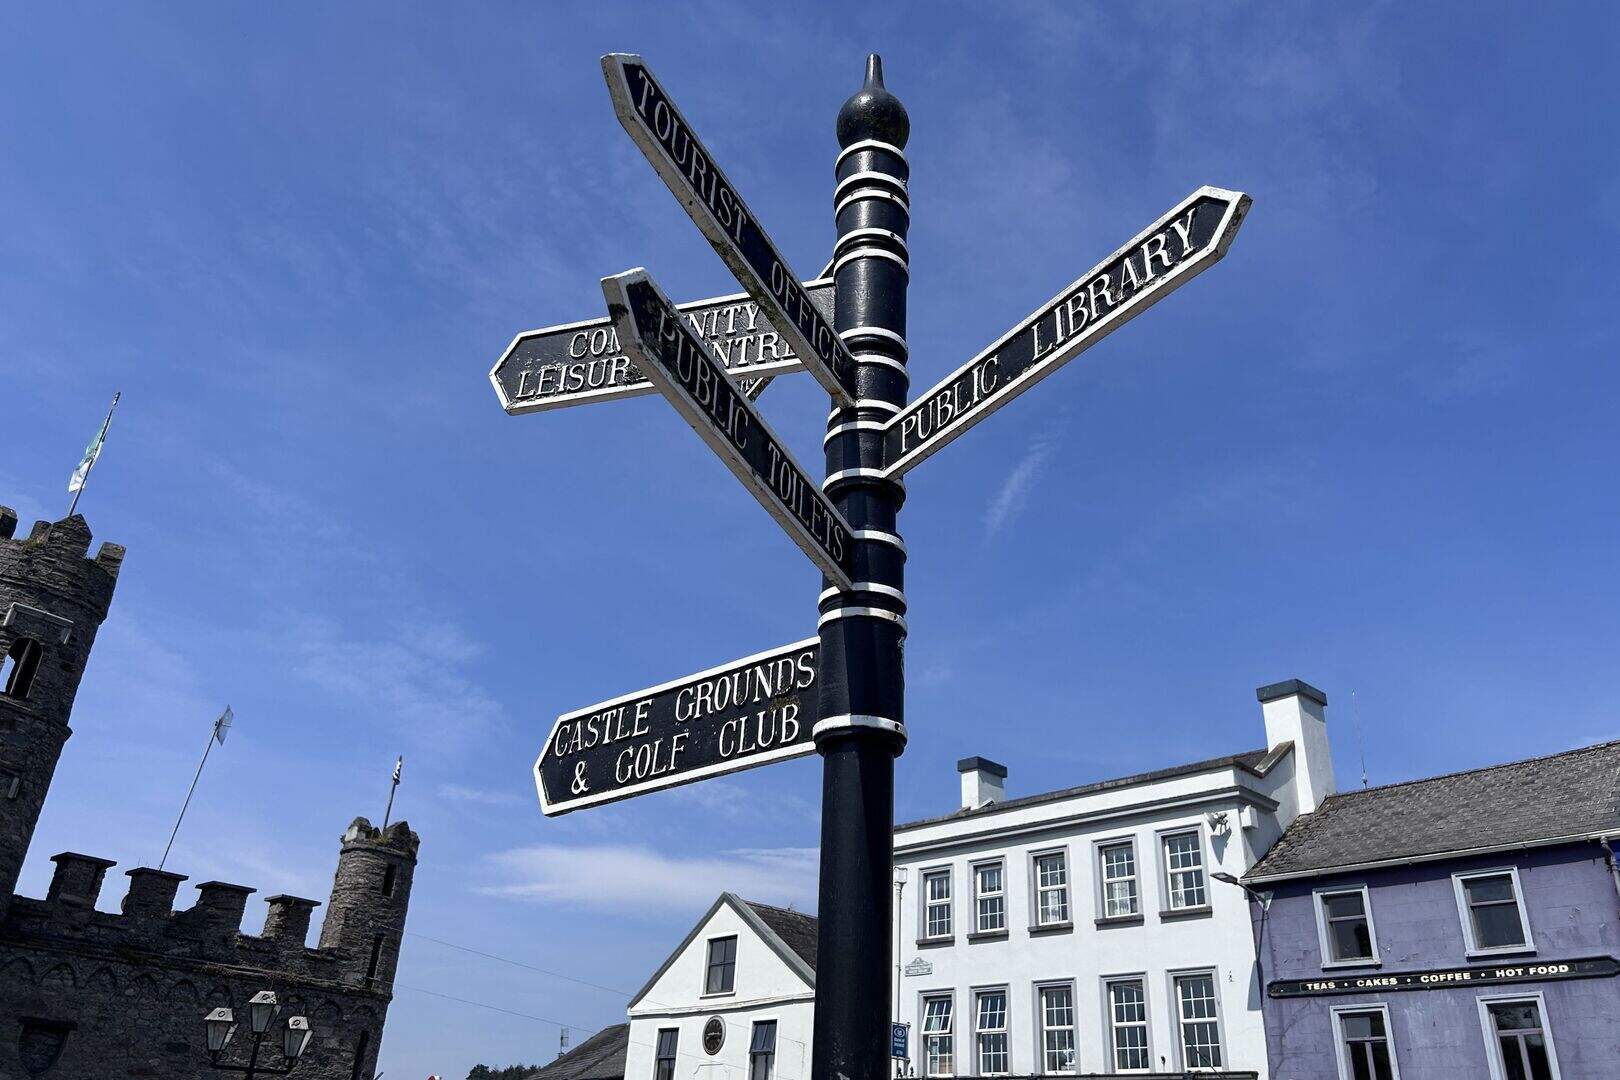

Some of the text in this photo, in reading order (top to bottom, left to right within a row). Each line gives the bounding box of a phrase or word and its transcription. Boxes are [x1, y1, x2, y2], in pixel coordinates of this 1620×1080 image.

[638, 70, 843, 380] TOURIST OFFICE
[516, 355, 648, 399] LEISUR
[900, 207, 1197, 454] PUBLIC LIBRARY
[658, 307, 844, 562] PUBLIC TOILETS
[555, 651, 816, 758] CASTLE GROUNDS
[570, 703, 801, 795] & GOLF CLUB
[1306, 964, 1569, 990] TEAS CAKES COFFEE HOT FOOD
